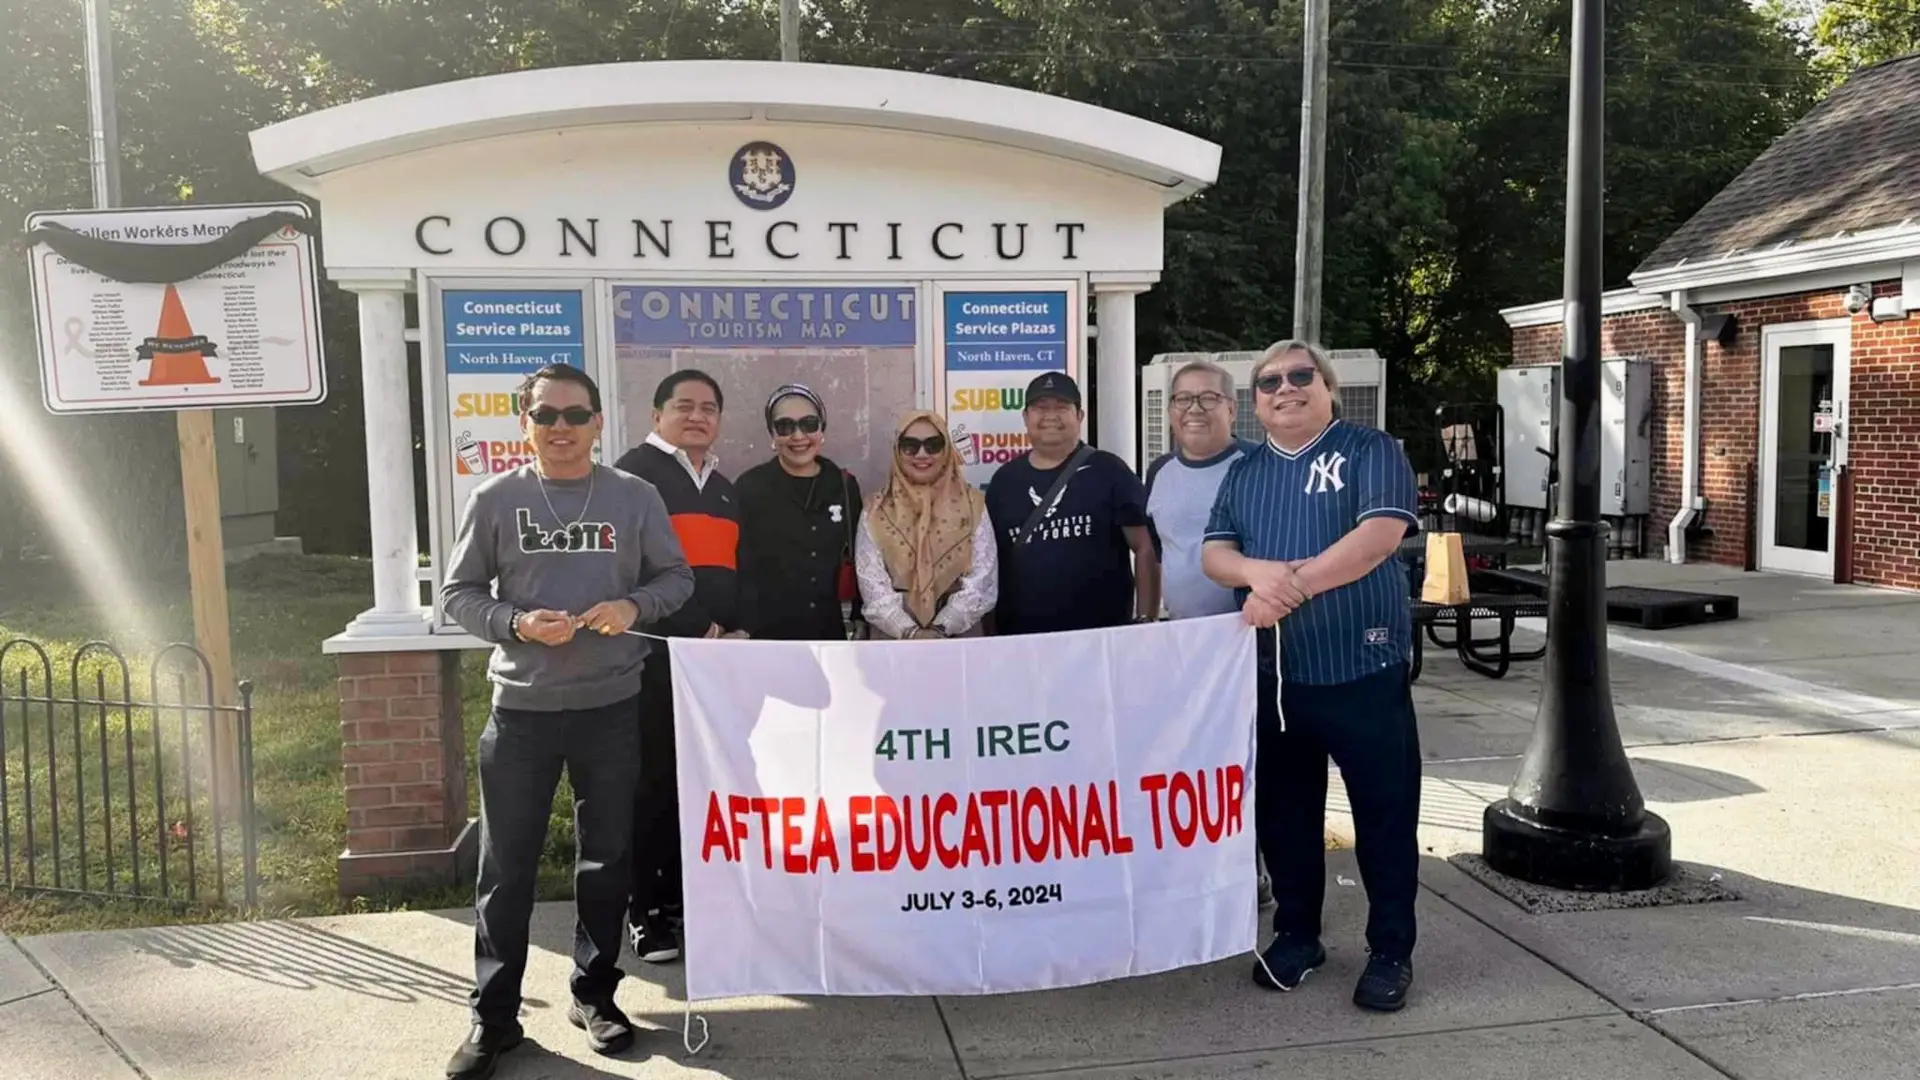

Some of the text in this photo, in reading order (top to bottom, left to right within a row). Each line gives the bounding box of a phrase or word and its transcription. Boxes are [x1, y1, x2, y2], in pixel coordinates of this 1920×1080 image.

[124, 225, 189, 239] Workers
[415, 215, 1085, 261] CONNECTICUT
[463, 301, 562, 315] Connecticut
[613, 290, 914, 321] CONNECTICUT
[962, 302, 1049, 315] Connecticut
[456, 322, 571, 336] Service Plazas
[688, 321, 847, 338] TOURISM MAP
[955, 322, 1056, 335] Service Plazas
[459, 352, 571, 365] North Haven, CT
[958, 350, 1055, 362] North Haven, CT
[1305, 451, 1346, 494] NY
[1050, 515, 1091, 529] STATES
[1042, 524, 1091, 541] FORCE
[875, 720, 1071, 761] 4TH IREC
[702, 764, 1245, 874] AFTEA EDUCATIONAL TOUR
[901, 884, 1062, 911] JULY 3-6, 2024
